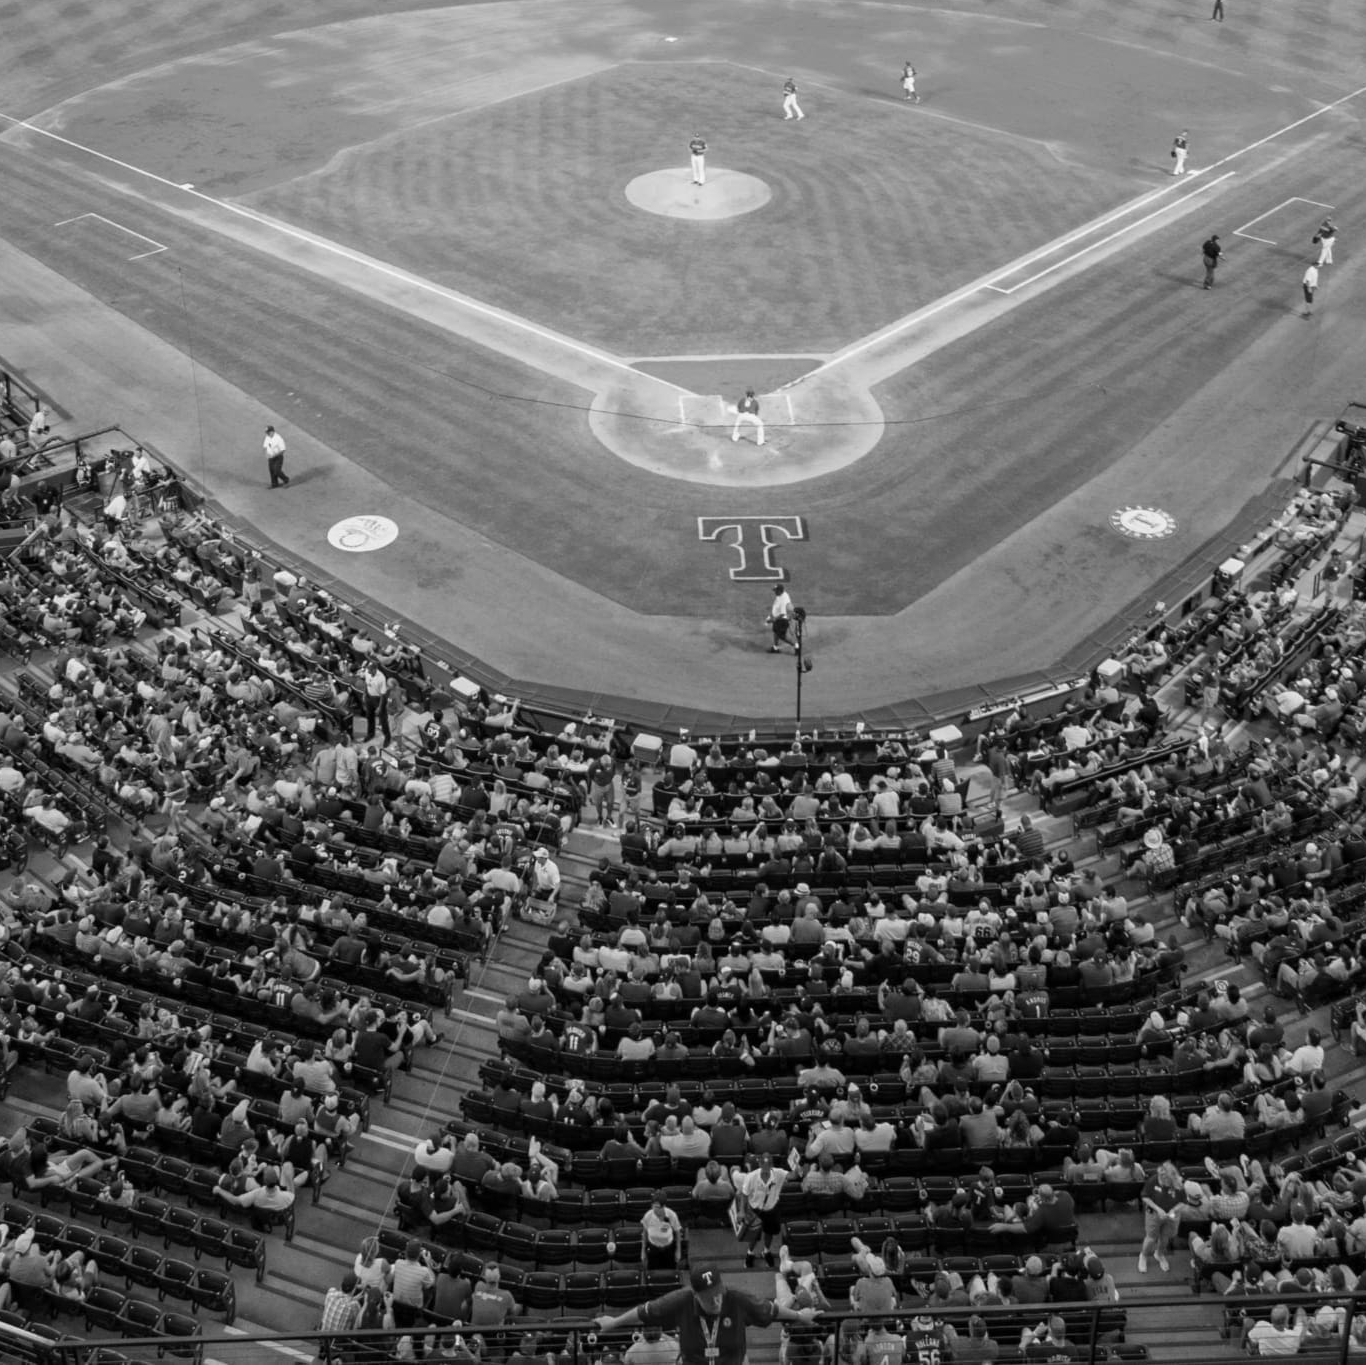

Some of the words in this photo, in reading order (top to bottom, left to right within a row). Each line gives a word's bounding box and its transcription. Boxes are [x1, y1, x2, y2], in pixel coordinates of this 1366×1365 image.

[697, 515, 807, 581] T
[974, 926, 992, 938] 66
[906, 948, 920, 963] 29
[276, 992, 285, 1006] 11
[1035, 1005, 1040, 1018] 1
[569, 1034, 578, 1050] 11
[702, 1271, 713, 1285] T
[918, 1349, 941, 1365] 56
